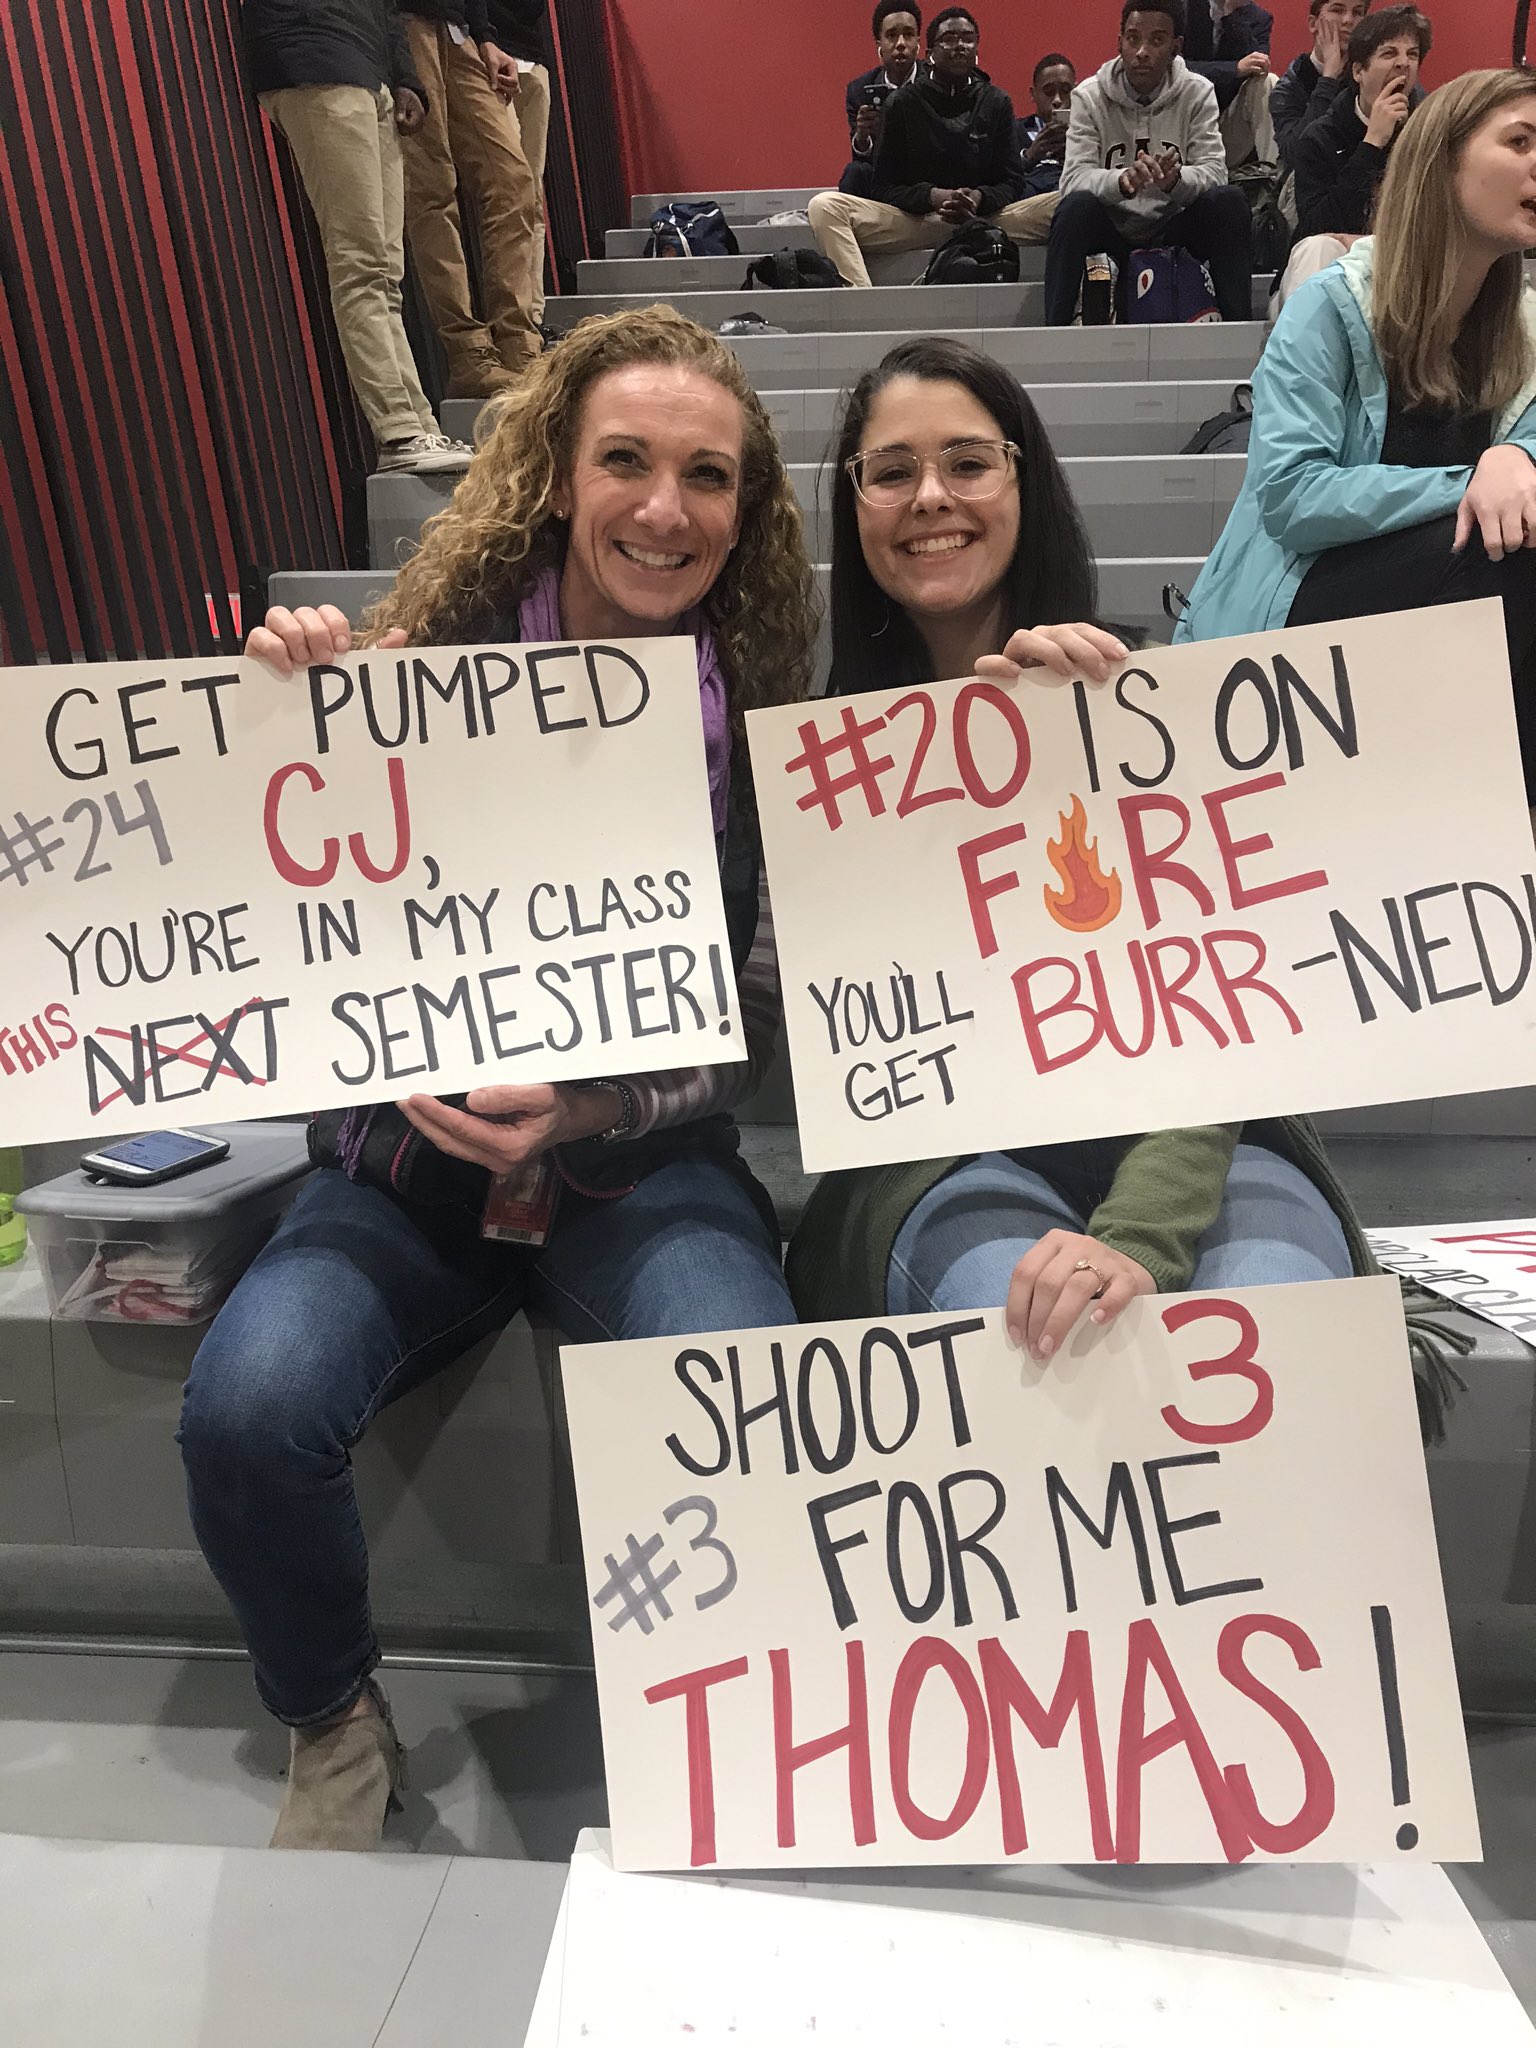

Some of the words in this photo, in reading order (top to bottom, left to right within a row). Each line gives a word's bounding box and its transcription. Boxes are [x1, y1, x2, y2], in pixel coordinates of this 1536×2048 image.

[46, 674, 241, 781] GET
[307, 644, 651, 755] PUMPED
[785, 682, 1032, 832] #20
[1072, 667, 1176, 793] IS
[1215, 645, 1360, 772] ON
[0, 779, 174, 887] #24
[263, 757, 441, 891] CJ,
[957, 771, 1329, 960] FRE
[45, 903, 260, 996] YOU'RE
[298, 898, 362, 966] IN
[404, 887, 500, 961] MY
[527, 870, 692, 942] CLASS
[0, 1002, 78, 1076] THIS
[83, 996, 290, 1117] NEXT
[331, 944, 731, 1087] SEMESTER!
[807, 961, 975, 1055] YOU'LL
[845, 1044, 957, 1122] GET
[665, 1317, 986, 1477] SHOOT
[1161, 1297, 1275, 1445] 3
[593, 1495, 738, 1635] #3
[807, 1468, 1021, 1632] FOR
[1045, 1450, 1265, 1614] ME
